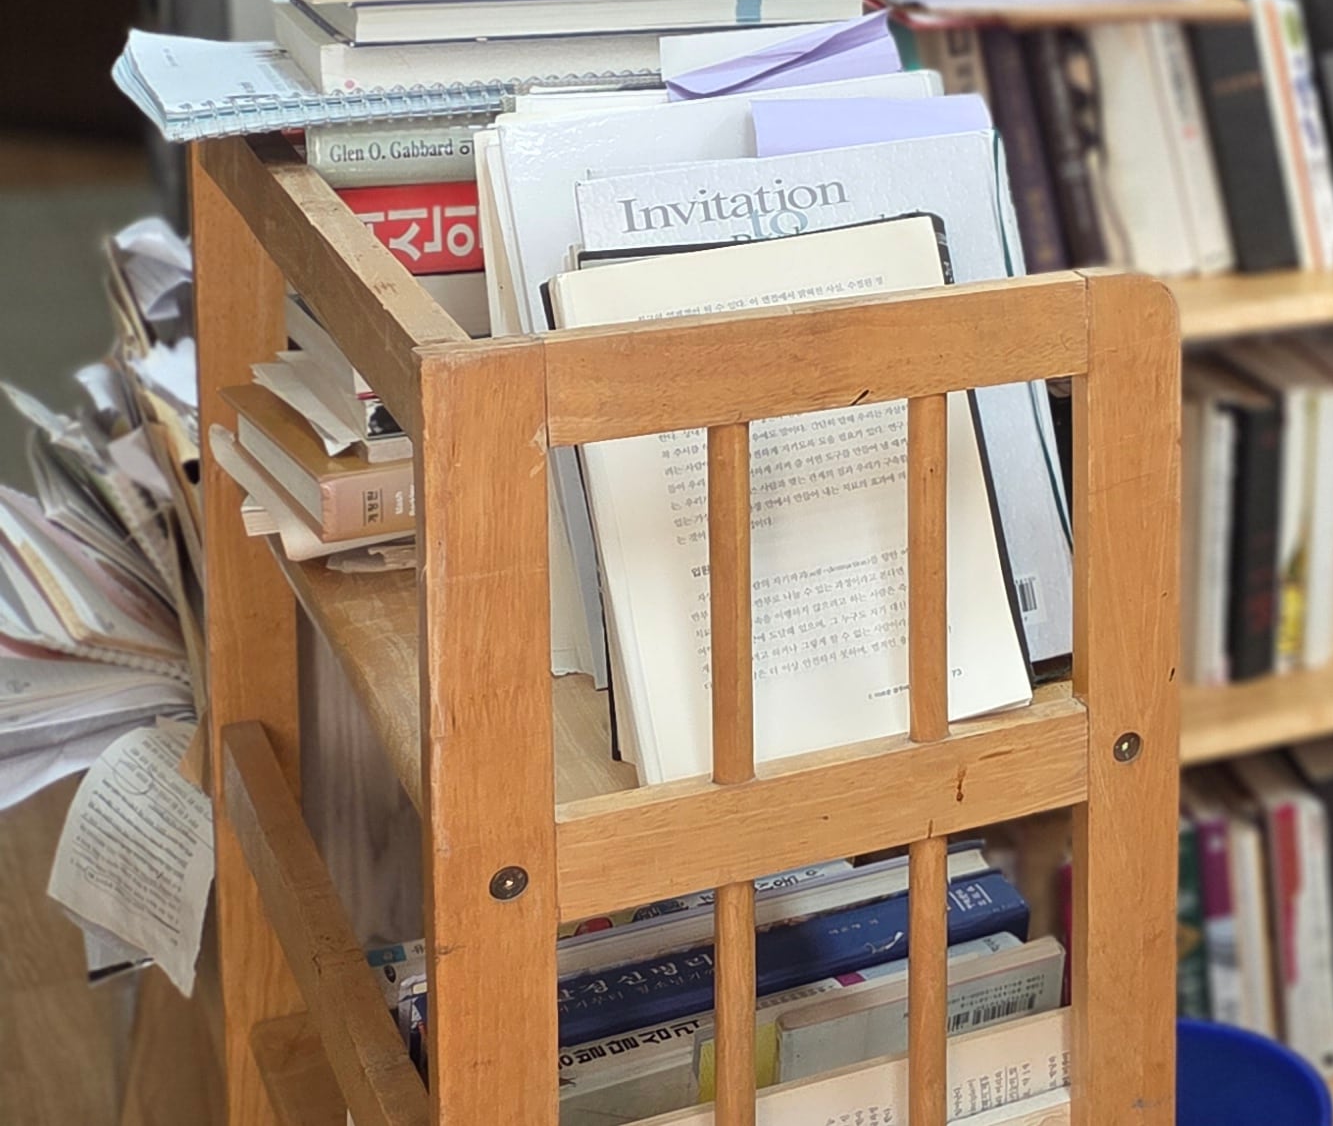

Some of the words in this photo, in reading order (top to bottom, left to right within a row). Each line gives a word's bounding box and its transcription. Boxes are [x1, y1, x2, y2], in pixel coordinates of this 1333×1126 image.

[330, 144, 364, 163] Glen
[368, 142, 386, 160] O.
[390, 139, 453, 159] Gabbard
[618, 178, 850, 234] Invitation
[751, 210, 808, 241] to
